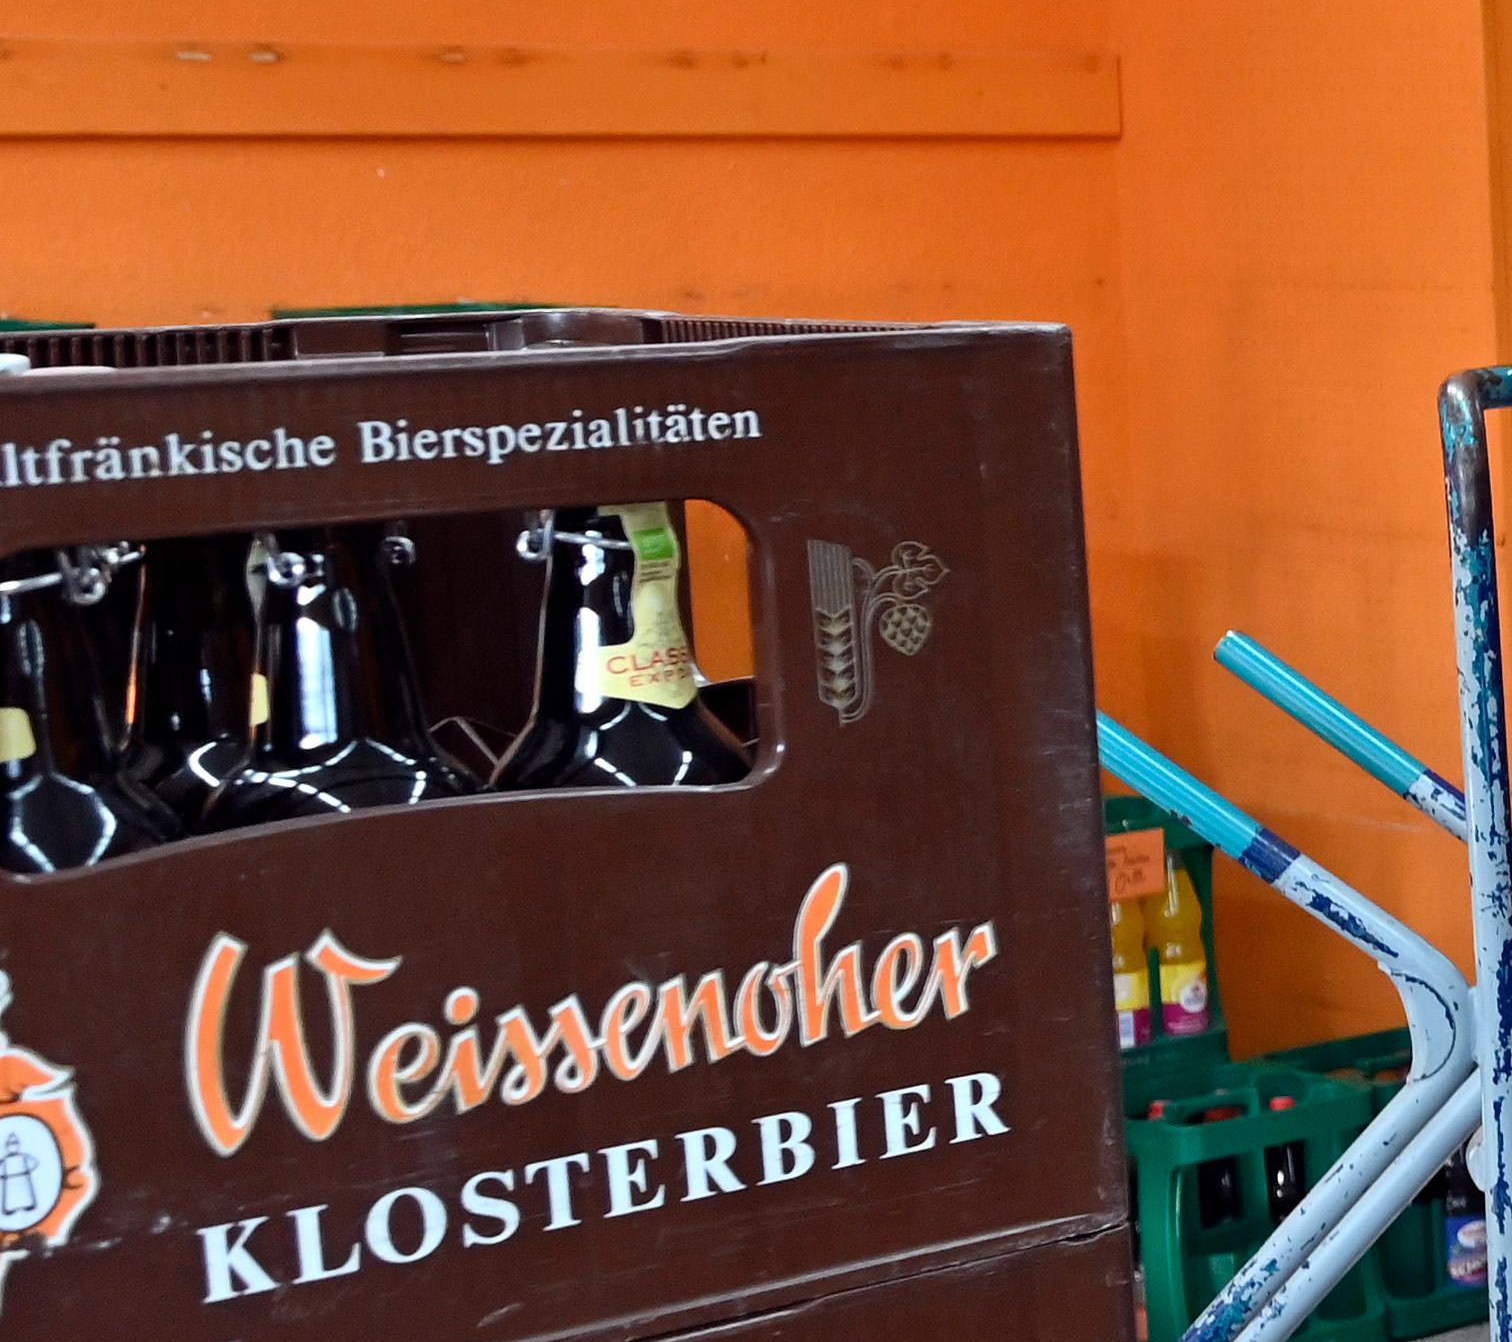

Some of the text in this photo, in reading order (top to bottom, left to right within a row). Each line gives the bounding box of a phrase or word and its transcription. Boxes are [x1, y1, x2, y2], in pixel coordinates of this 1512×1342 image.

[0, 404, 762, 487] ltfränkische Bierspezialitäten
[185, 862, 996, 1157] Weissenoher
[198, 1071, 1012, 1305] KLOSTERBIER
